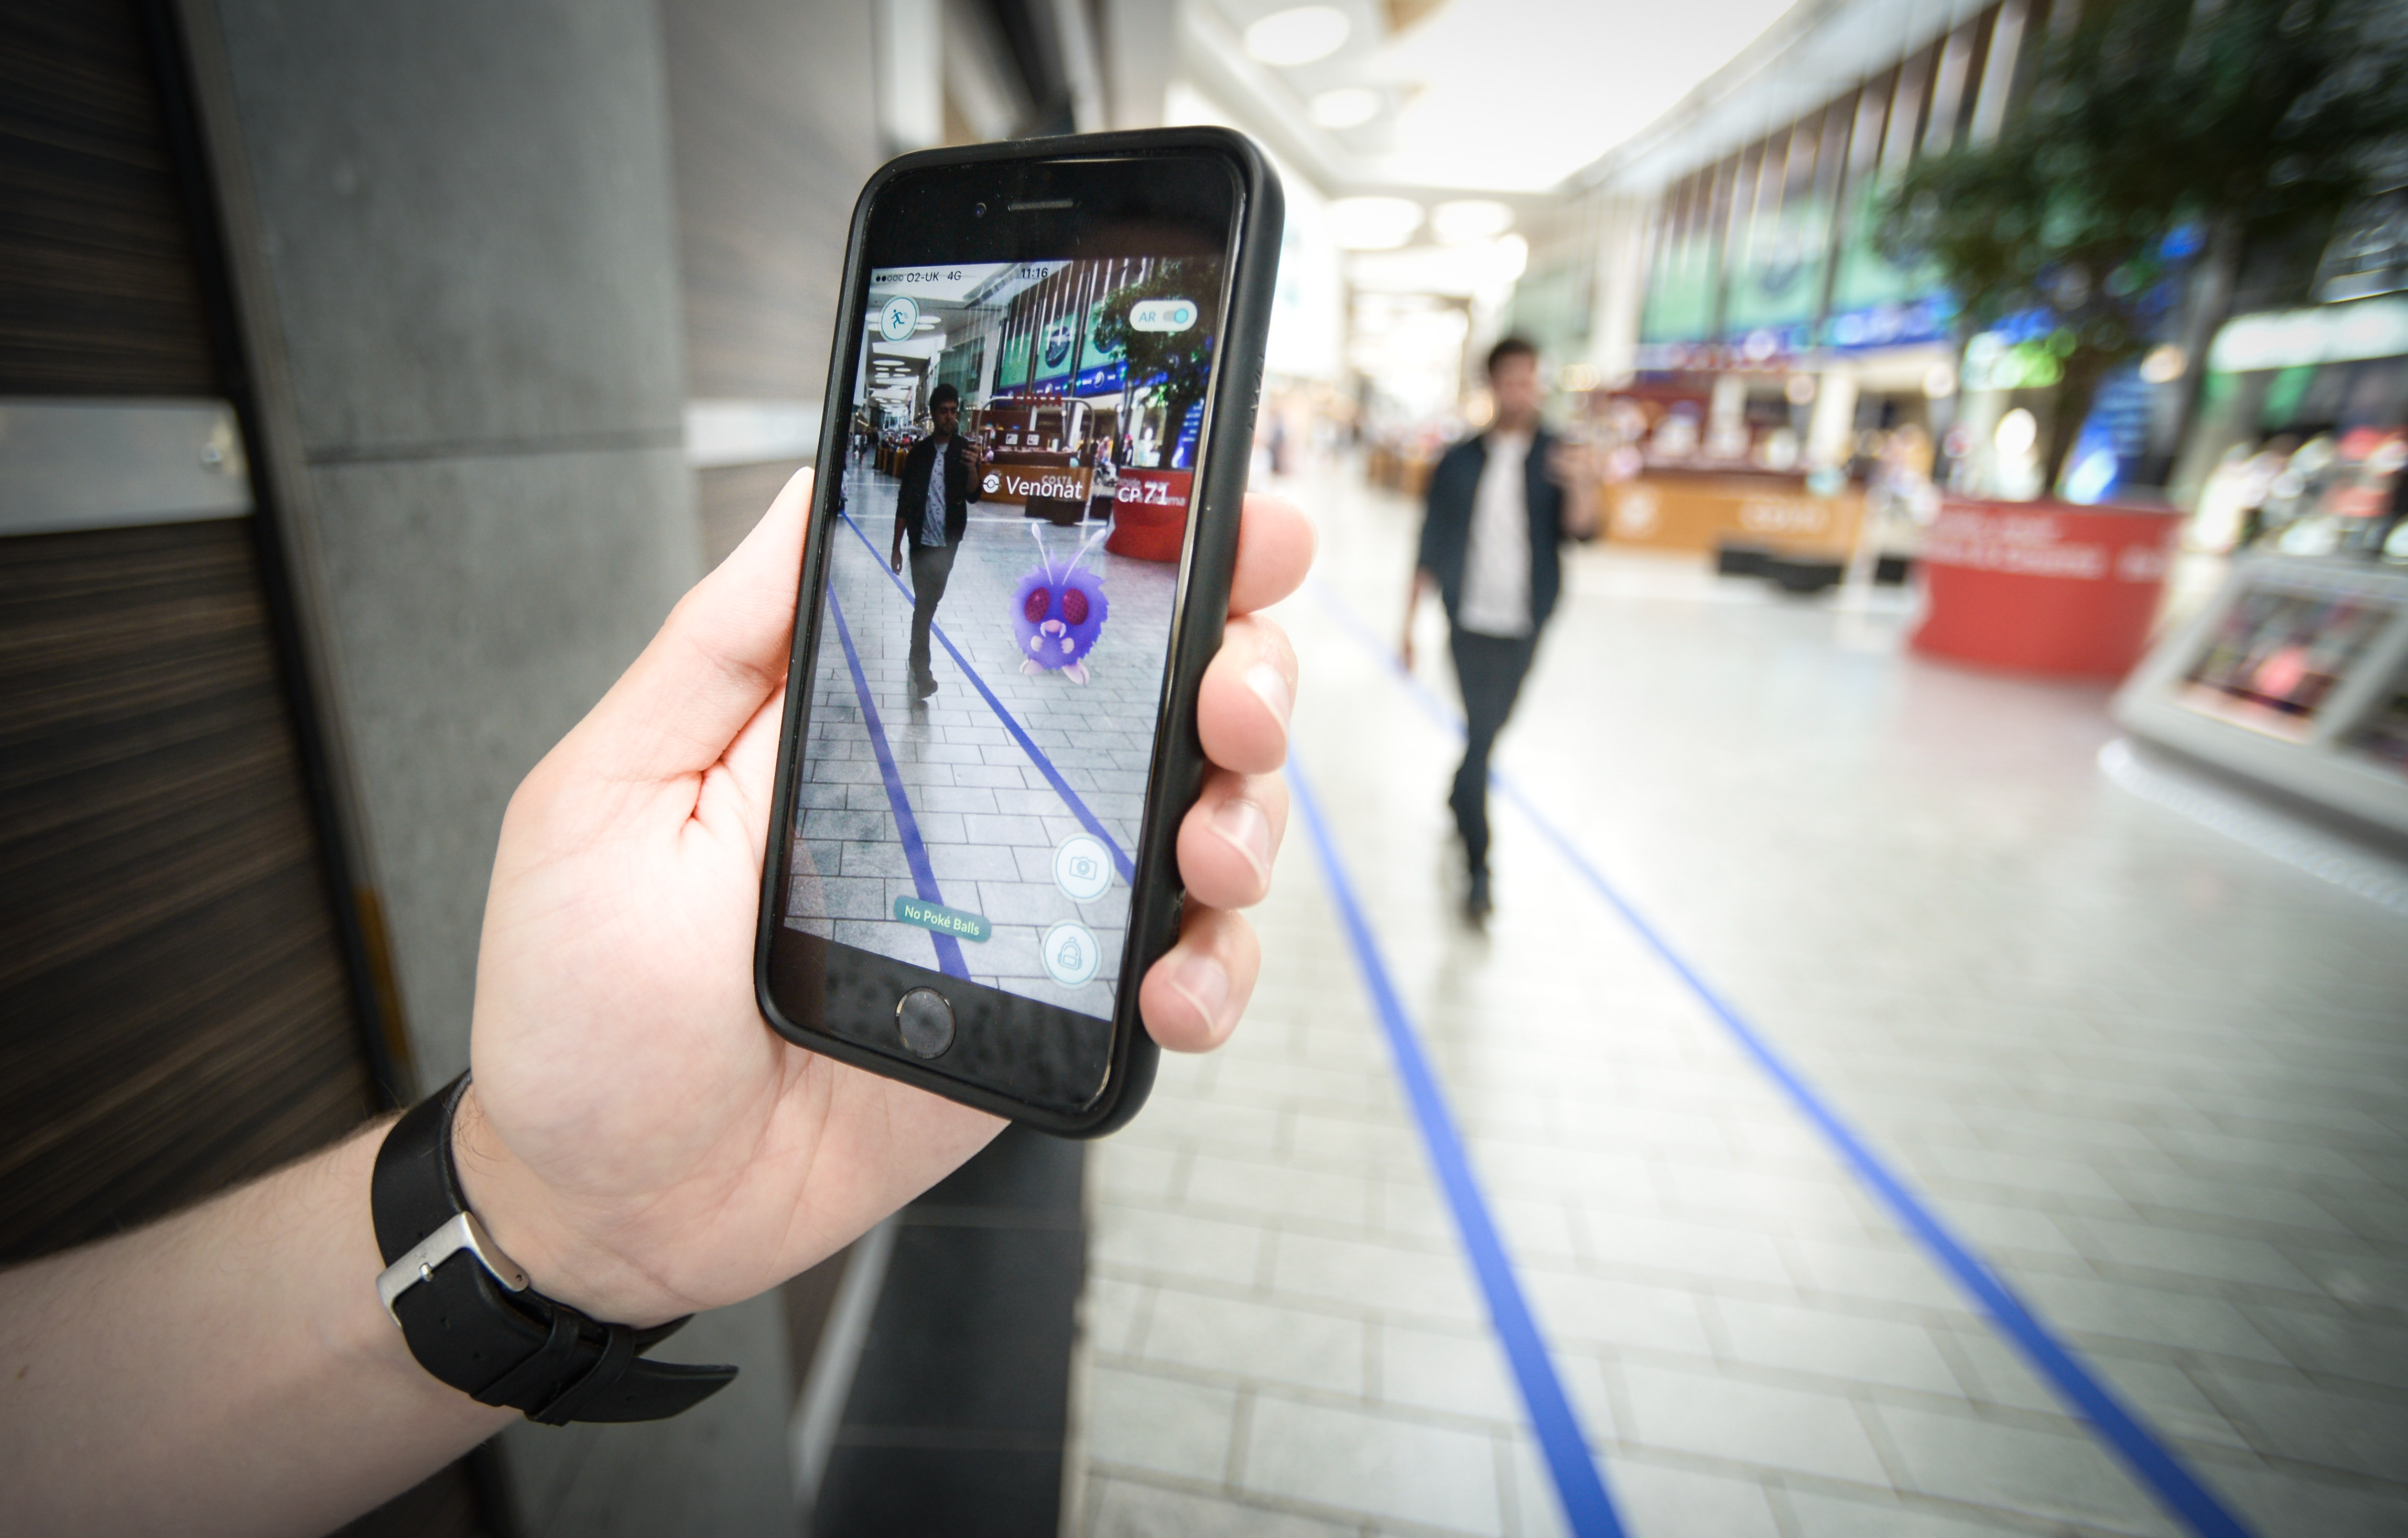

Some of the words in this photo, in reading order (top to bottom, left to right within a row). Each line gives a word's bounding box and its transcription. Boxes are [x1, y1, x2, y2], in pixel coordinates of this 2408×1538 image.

[906, 272, 939, 282] O2-UK
[947, 271, 961, 281] 4G
[1022, 268, 1048, 279] 11:16
[1138, 311, 1156, 322] AR
[1042, 475, 1072, 485] COSTA
[1006, 476, 1083, 499] Venonat
[1118, 487, 1141, 503] CP
[1144, 481, 1170, 506] 71
[904, 905, 921, 920] No
[924, 910, 951, 928] Poké
[953, 918, 980, 936] Balls
